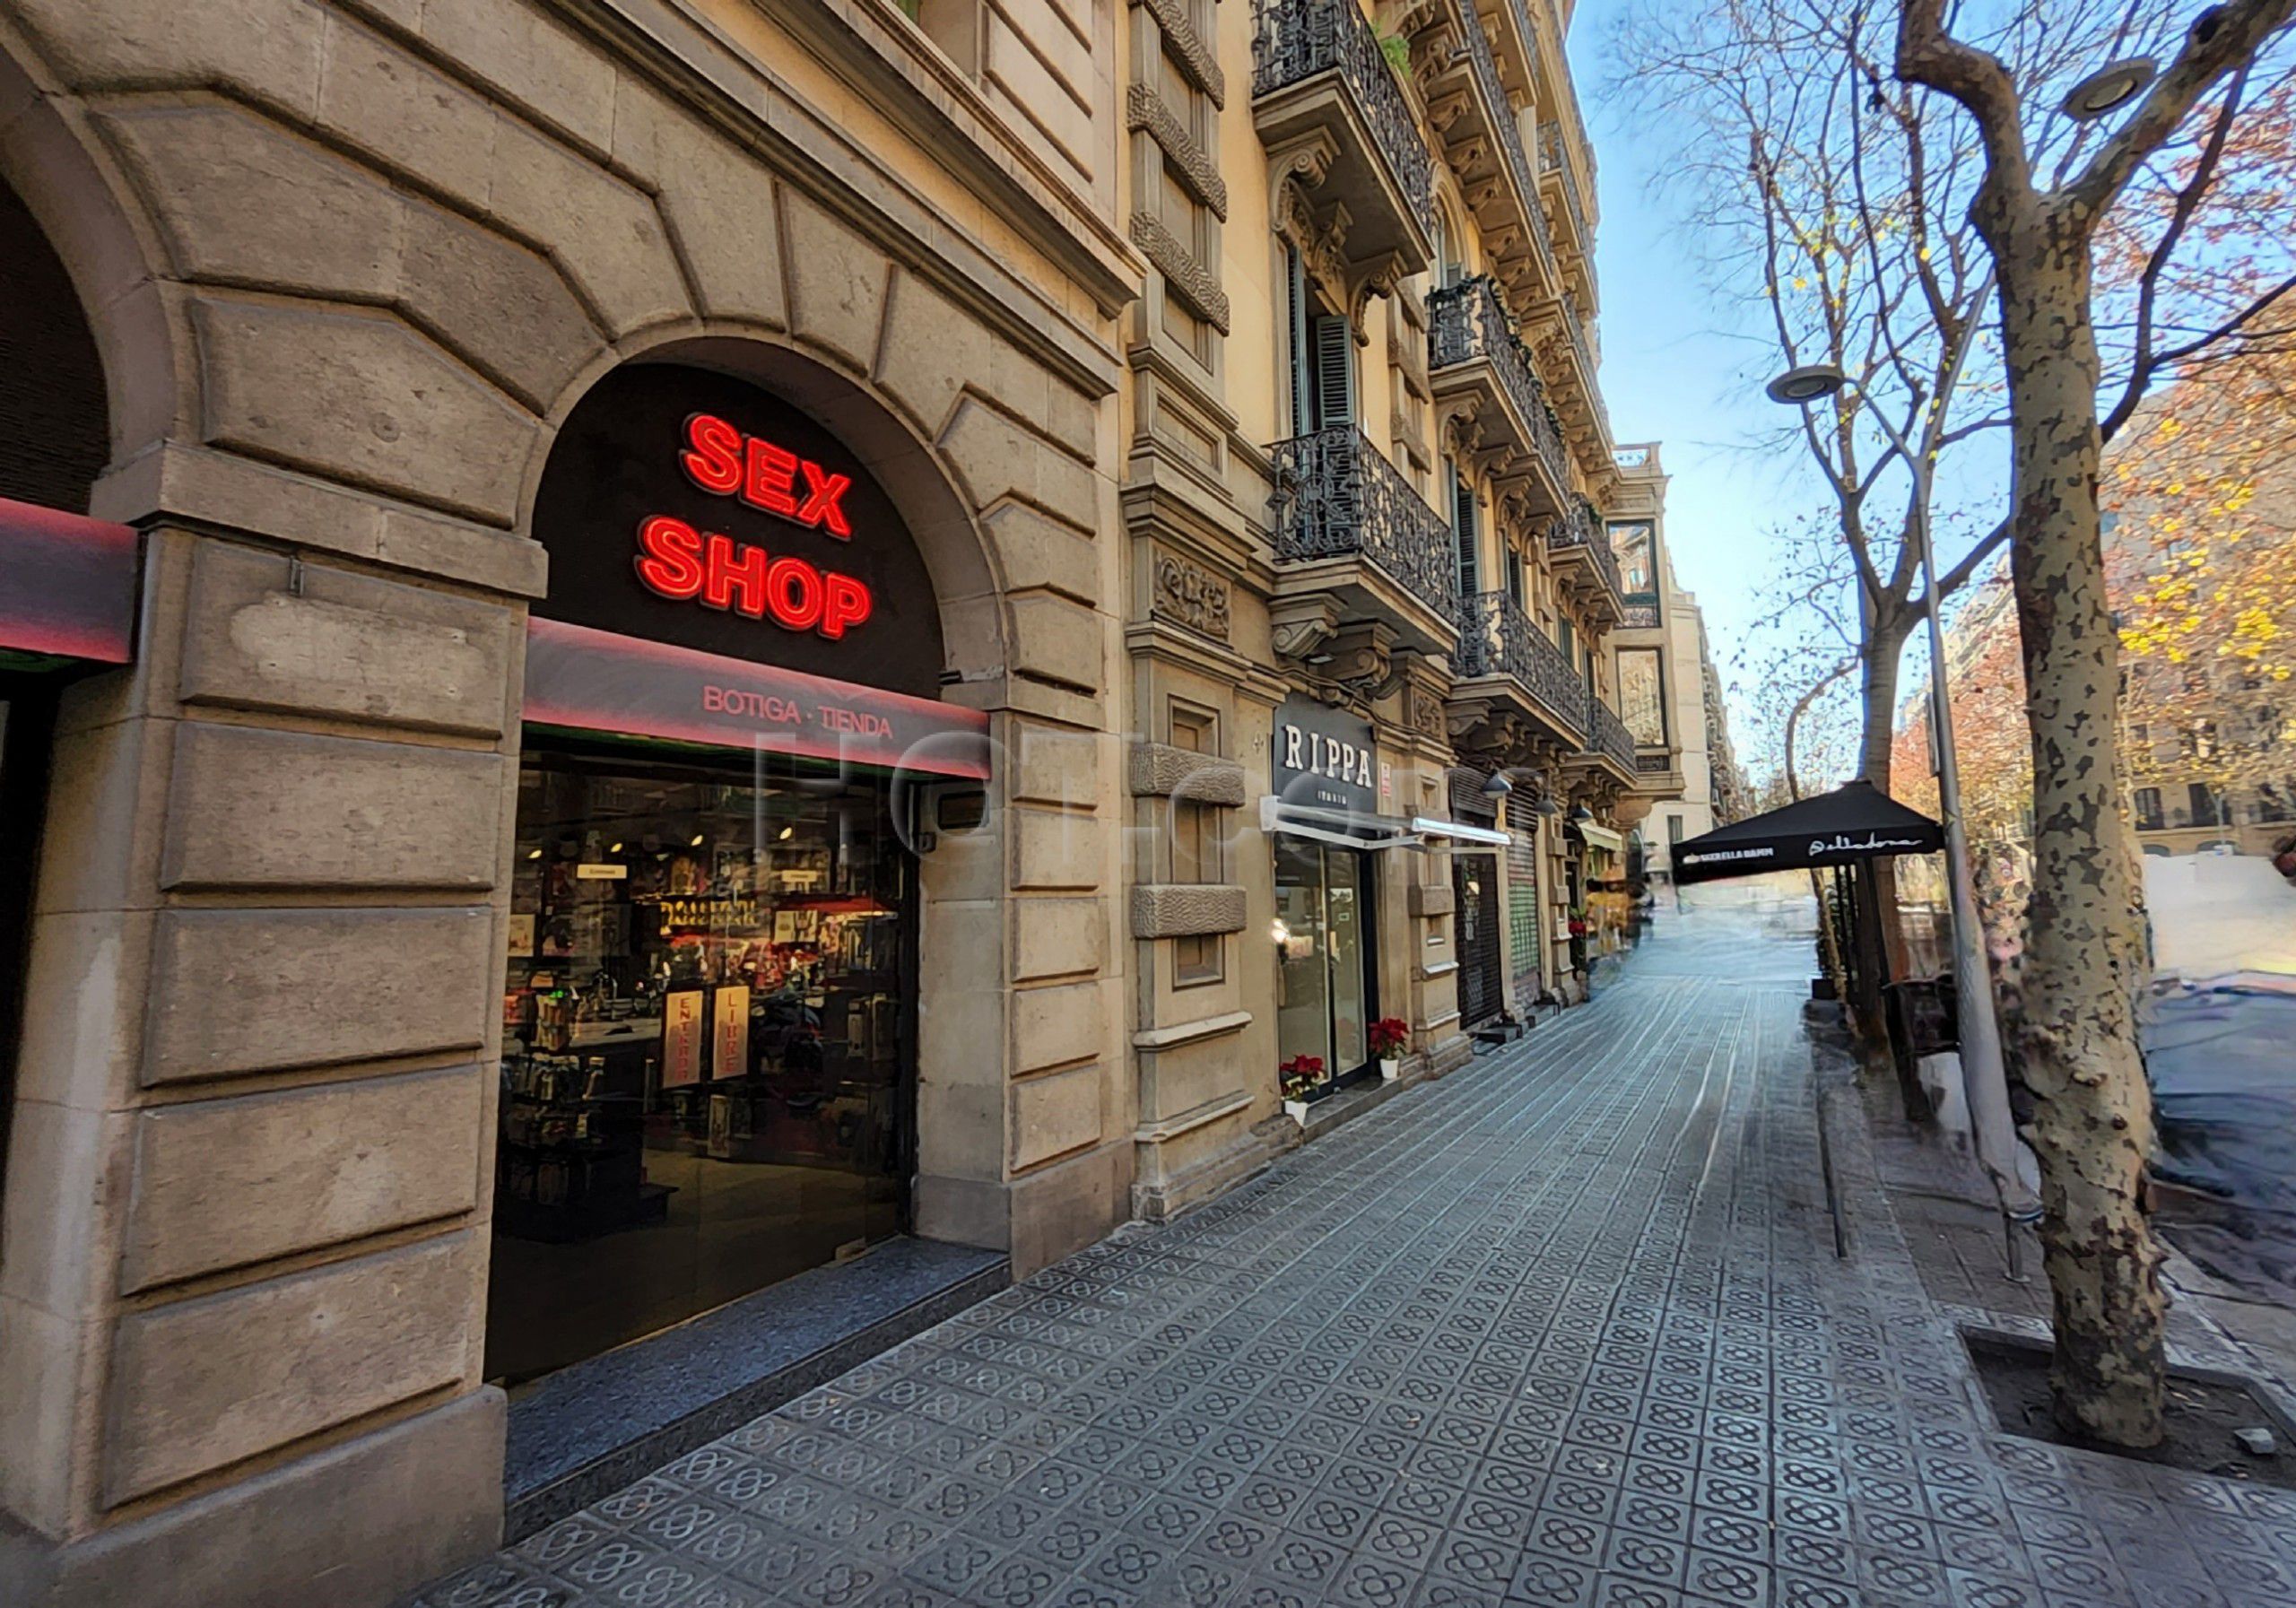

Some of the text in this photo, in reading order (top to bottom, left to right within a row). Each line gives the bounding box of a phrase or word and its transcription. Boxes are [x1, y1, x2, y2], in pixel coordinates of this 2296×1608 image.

[681, 413, 853, 541] SEX
[636, 515, 874, 639] SHOP
[703, 685, 893, 739] BOTIGA TIENDA
[1284, 725, 1373, 788] RIPPA
